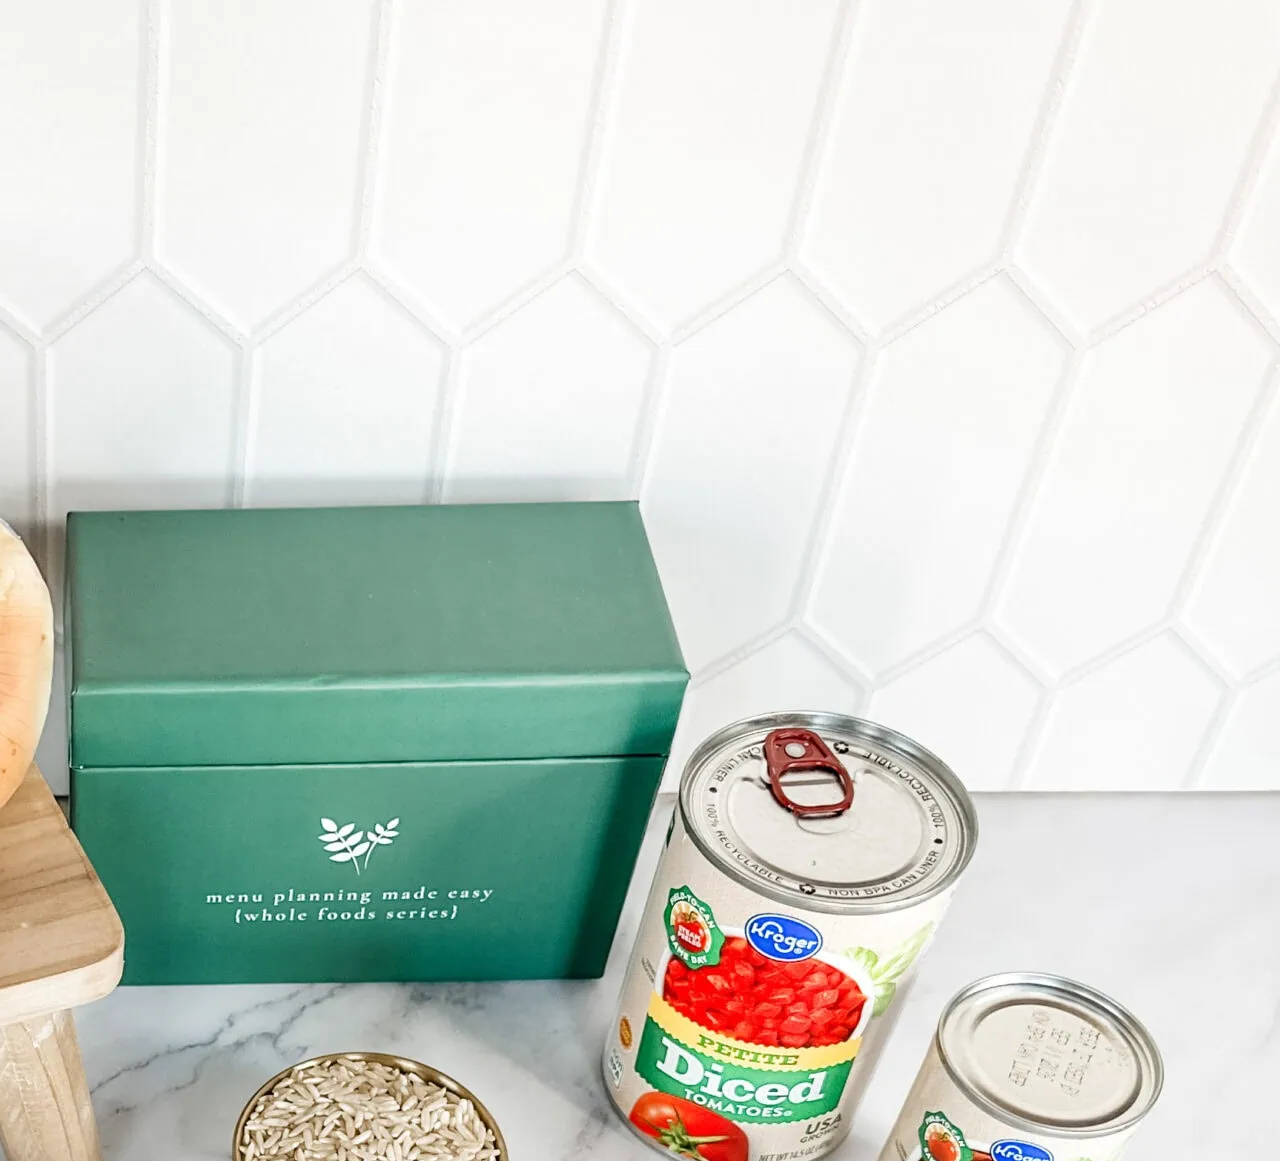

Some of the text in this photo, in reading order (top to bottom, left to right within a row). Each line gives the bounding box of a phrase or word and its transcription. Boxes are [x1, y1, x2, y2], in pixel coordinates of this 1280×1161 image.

[714, 746, 761, 783] CAN LINER
[862, 752, 944, 828] 100% RECYCLABLE
[706, 803, 784, 881] 100% RECYCLABLE
[827, 850, 940, 897] NON BPA CAN LINER
[206, 886, 494, 906] menu planning made easy
[317, 907, 376, 922] foods
[670, 934, 707, 964] SAME DAY
[696, 1034, 800, 1067] PETITE
[656, 1036, 827, 1106] Diced
[684, 1088, 784, 1118] TOMATOES
[800, 1123, 840, 1143] GROWN
[805, 1113, 842, 1135] USA
[776, 1152, 789, 1161] WT
